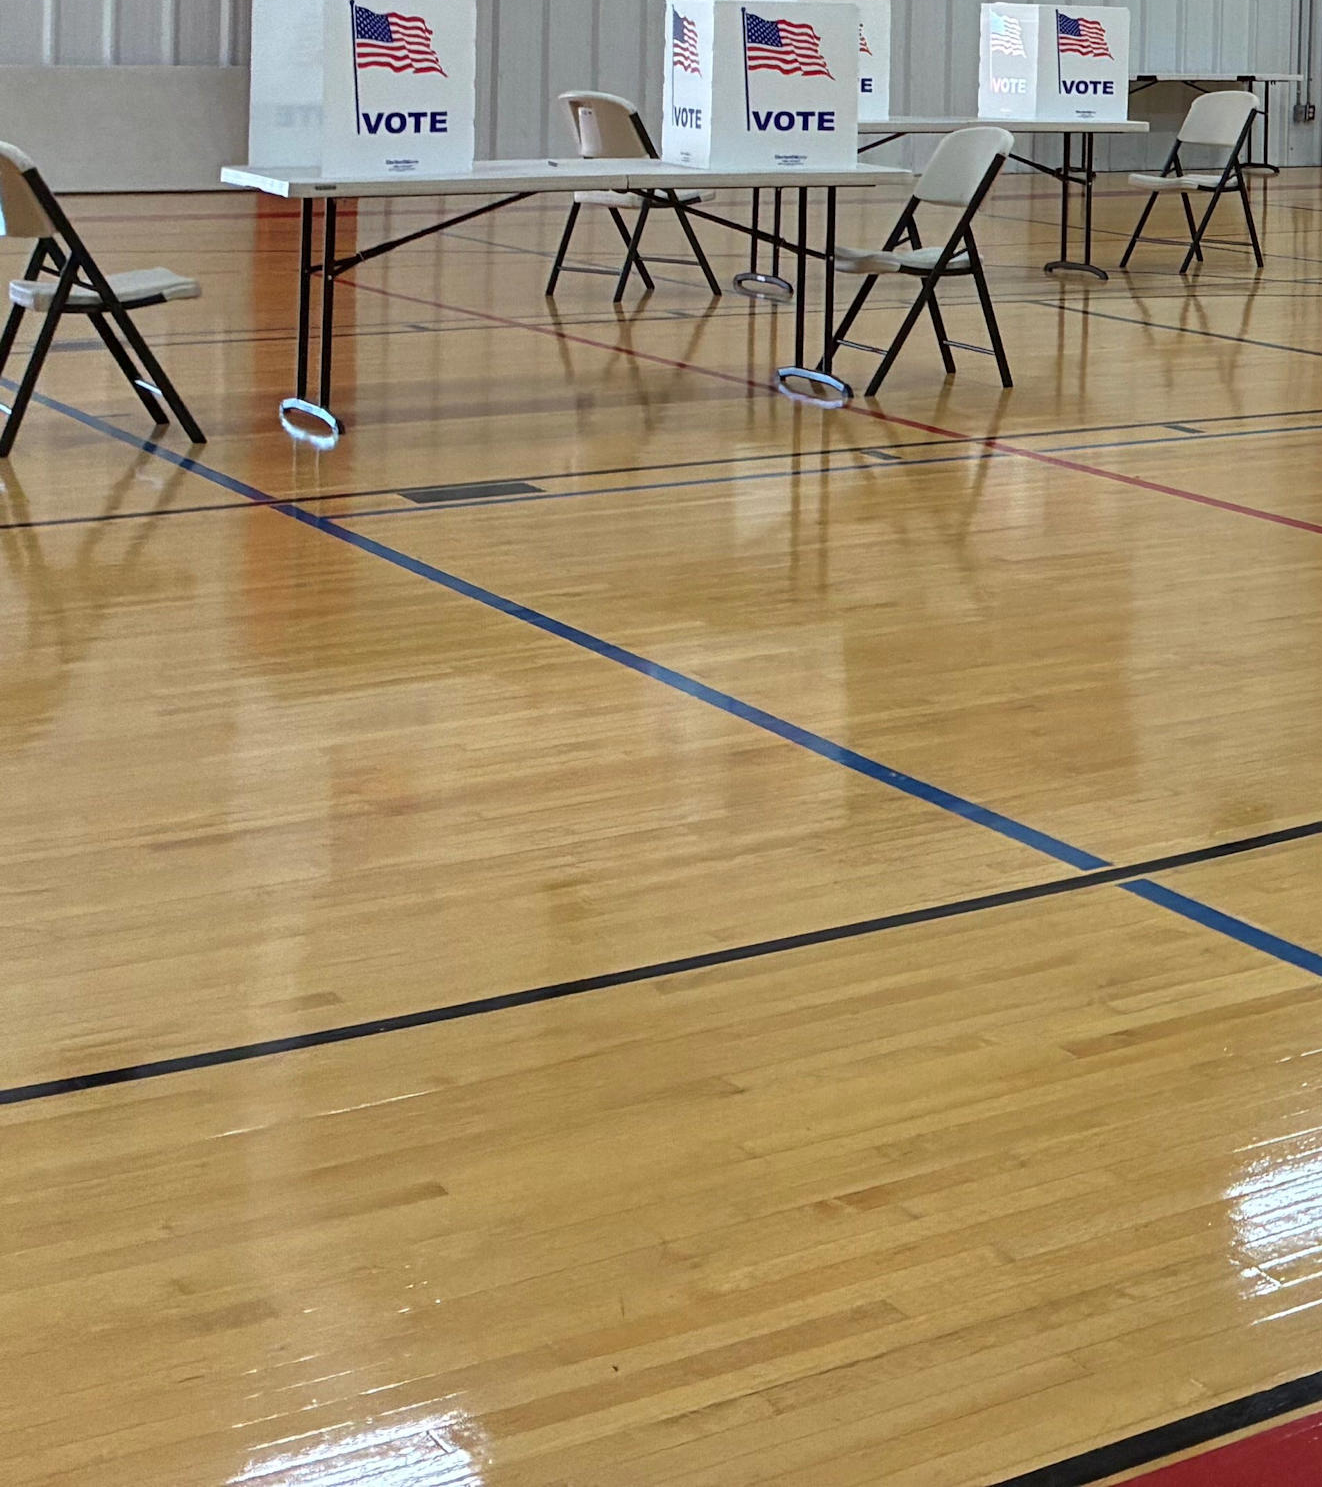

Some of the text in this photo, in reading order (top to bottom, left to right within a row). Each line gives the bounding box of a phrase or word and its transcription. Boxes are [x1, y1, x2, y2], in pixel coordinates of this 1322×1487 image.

[992, 77, 1027, 94] VOTE
[1062, 80, 1114, 95] VOTE
[361, 111, 448, 135] VOTE
[674, 106, 702, 129] VOTE
[752, 111, 835, 131] VOTE
